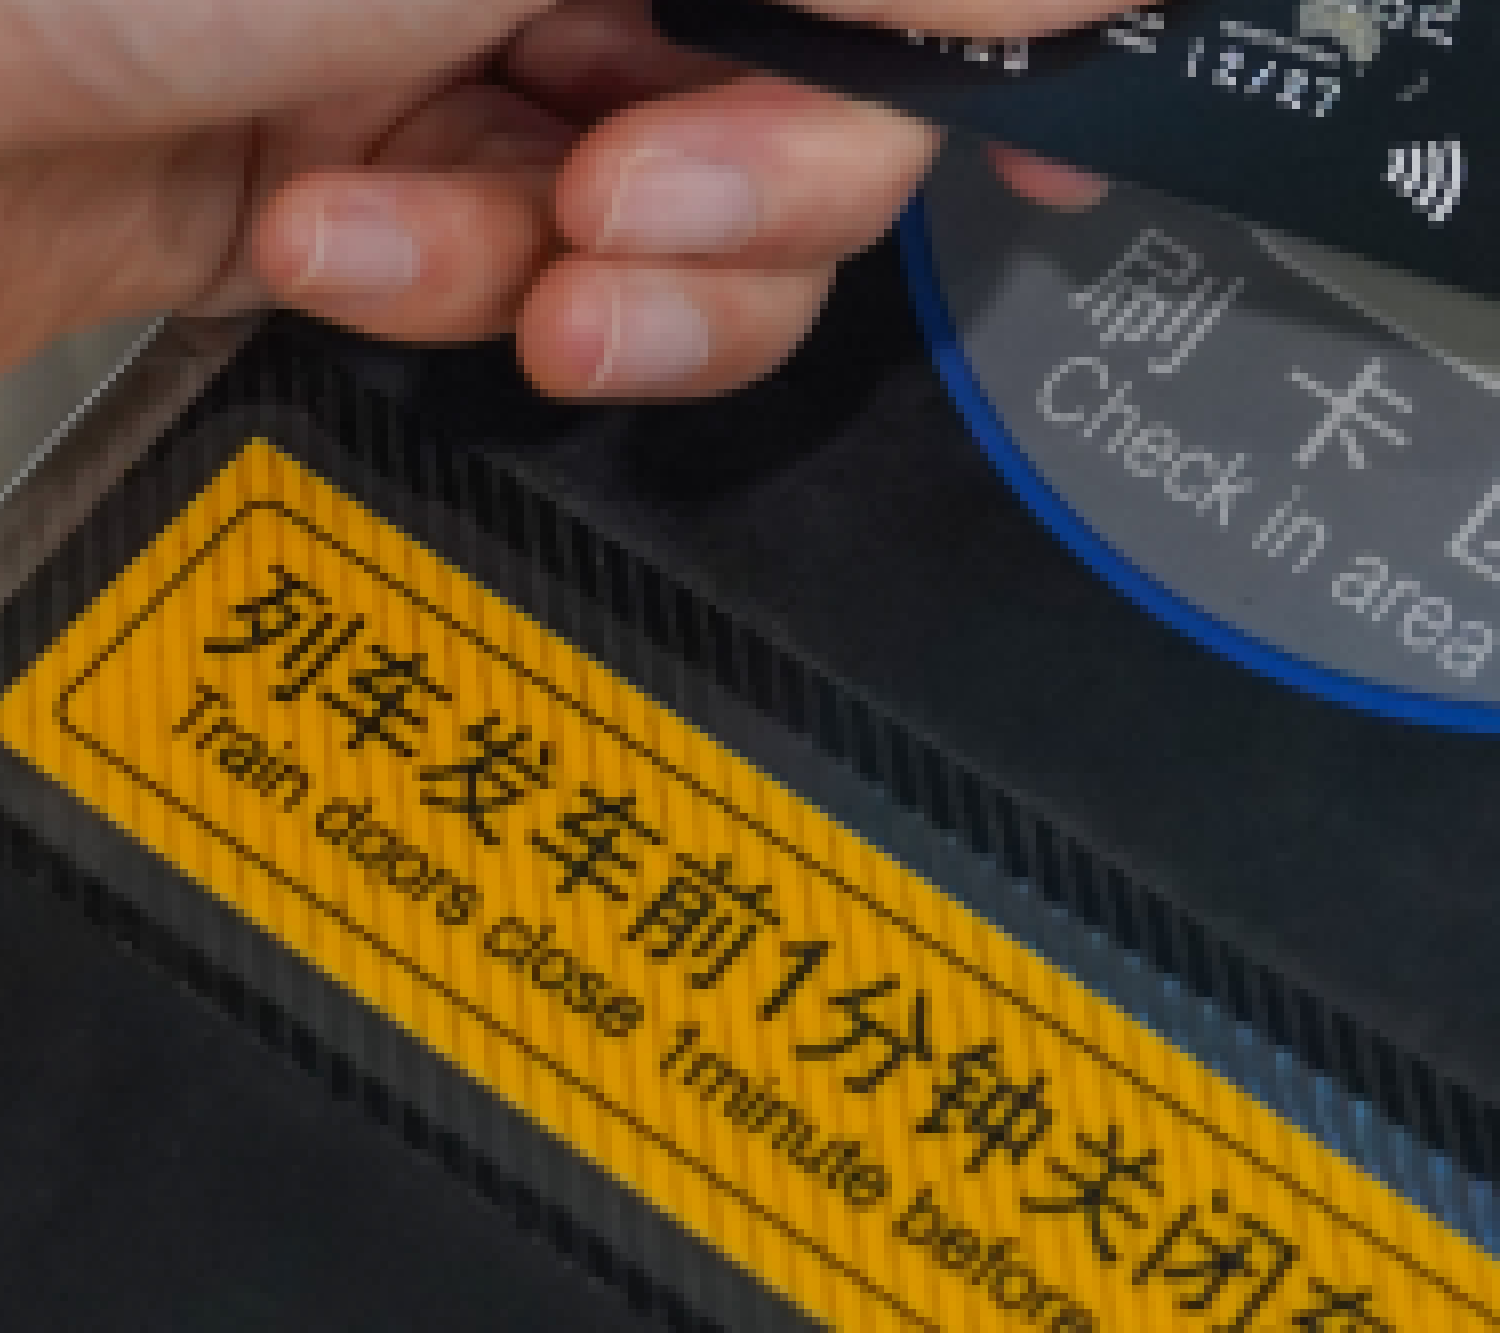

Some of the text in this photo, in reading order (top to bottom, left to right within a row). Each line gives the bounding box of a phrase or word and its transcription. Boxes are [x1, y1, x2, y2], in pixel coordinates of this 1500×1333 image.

[1186, 36, 1342, 119] 12/27
[1035, 356, 1495, 679] Check in area
[168, 681, 313, 814] Train
[312, 793, 482, 929] doors
[481, 913, 646, 1039] close
[893, 1186, 1098, 1333] before
